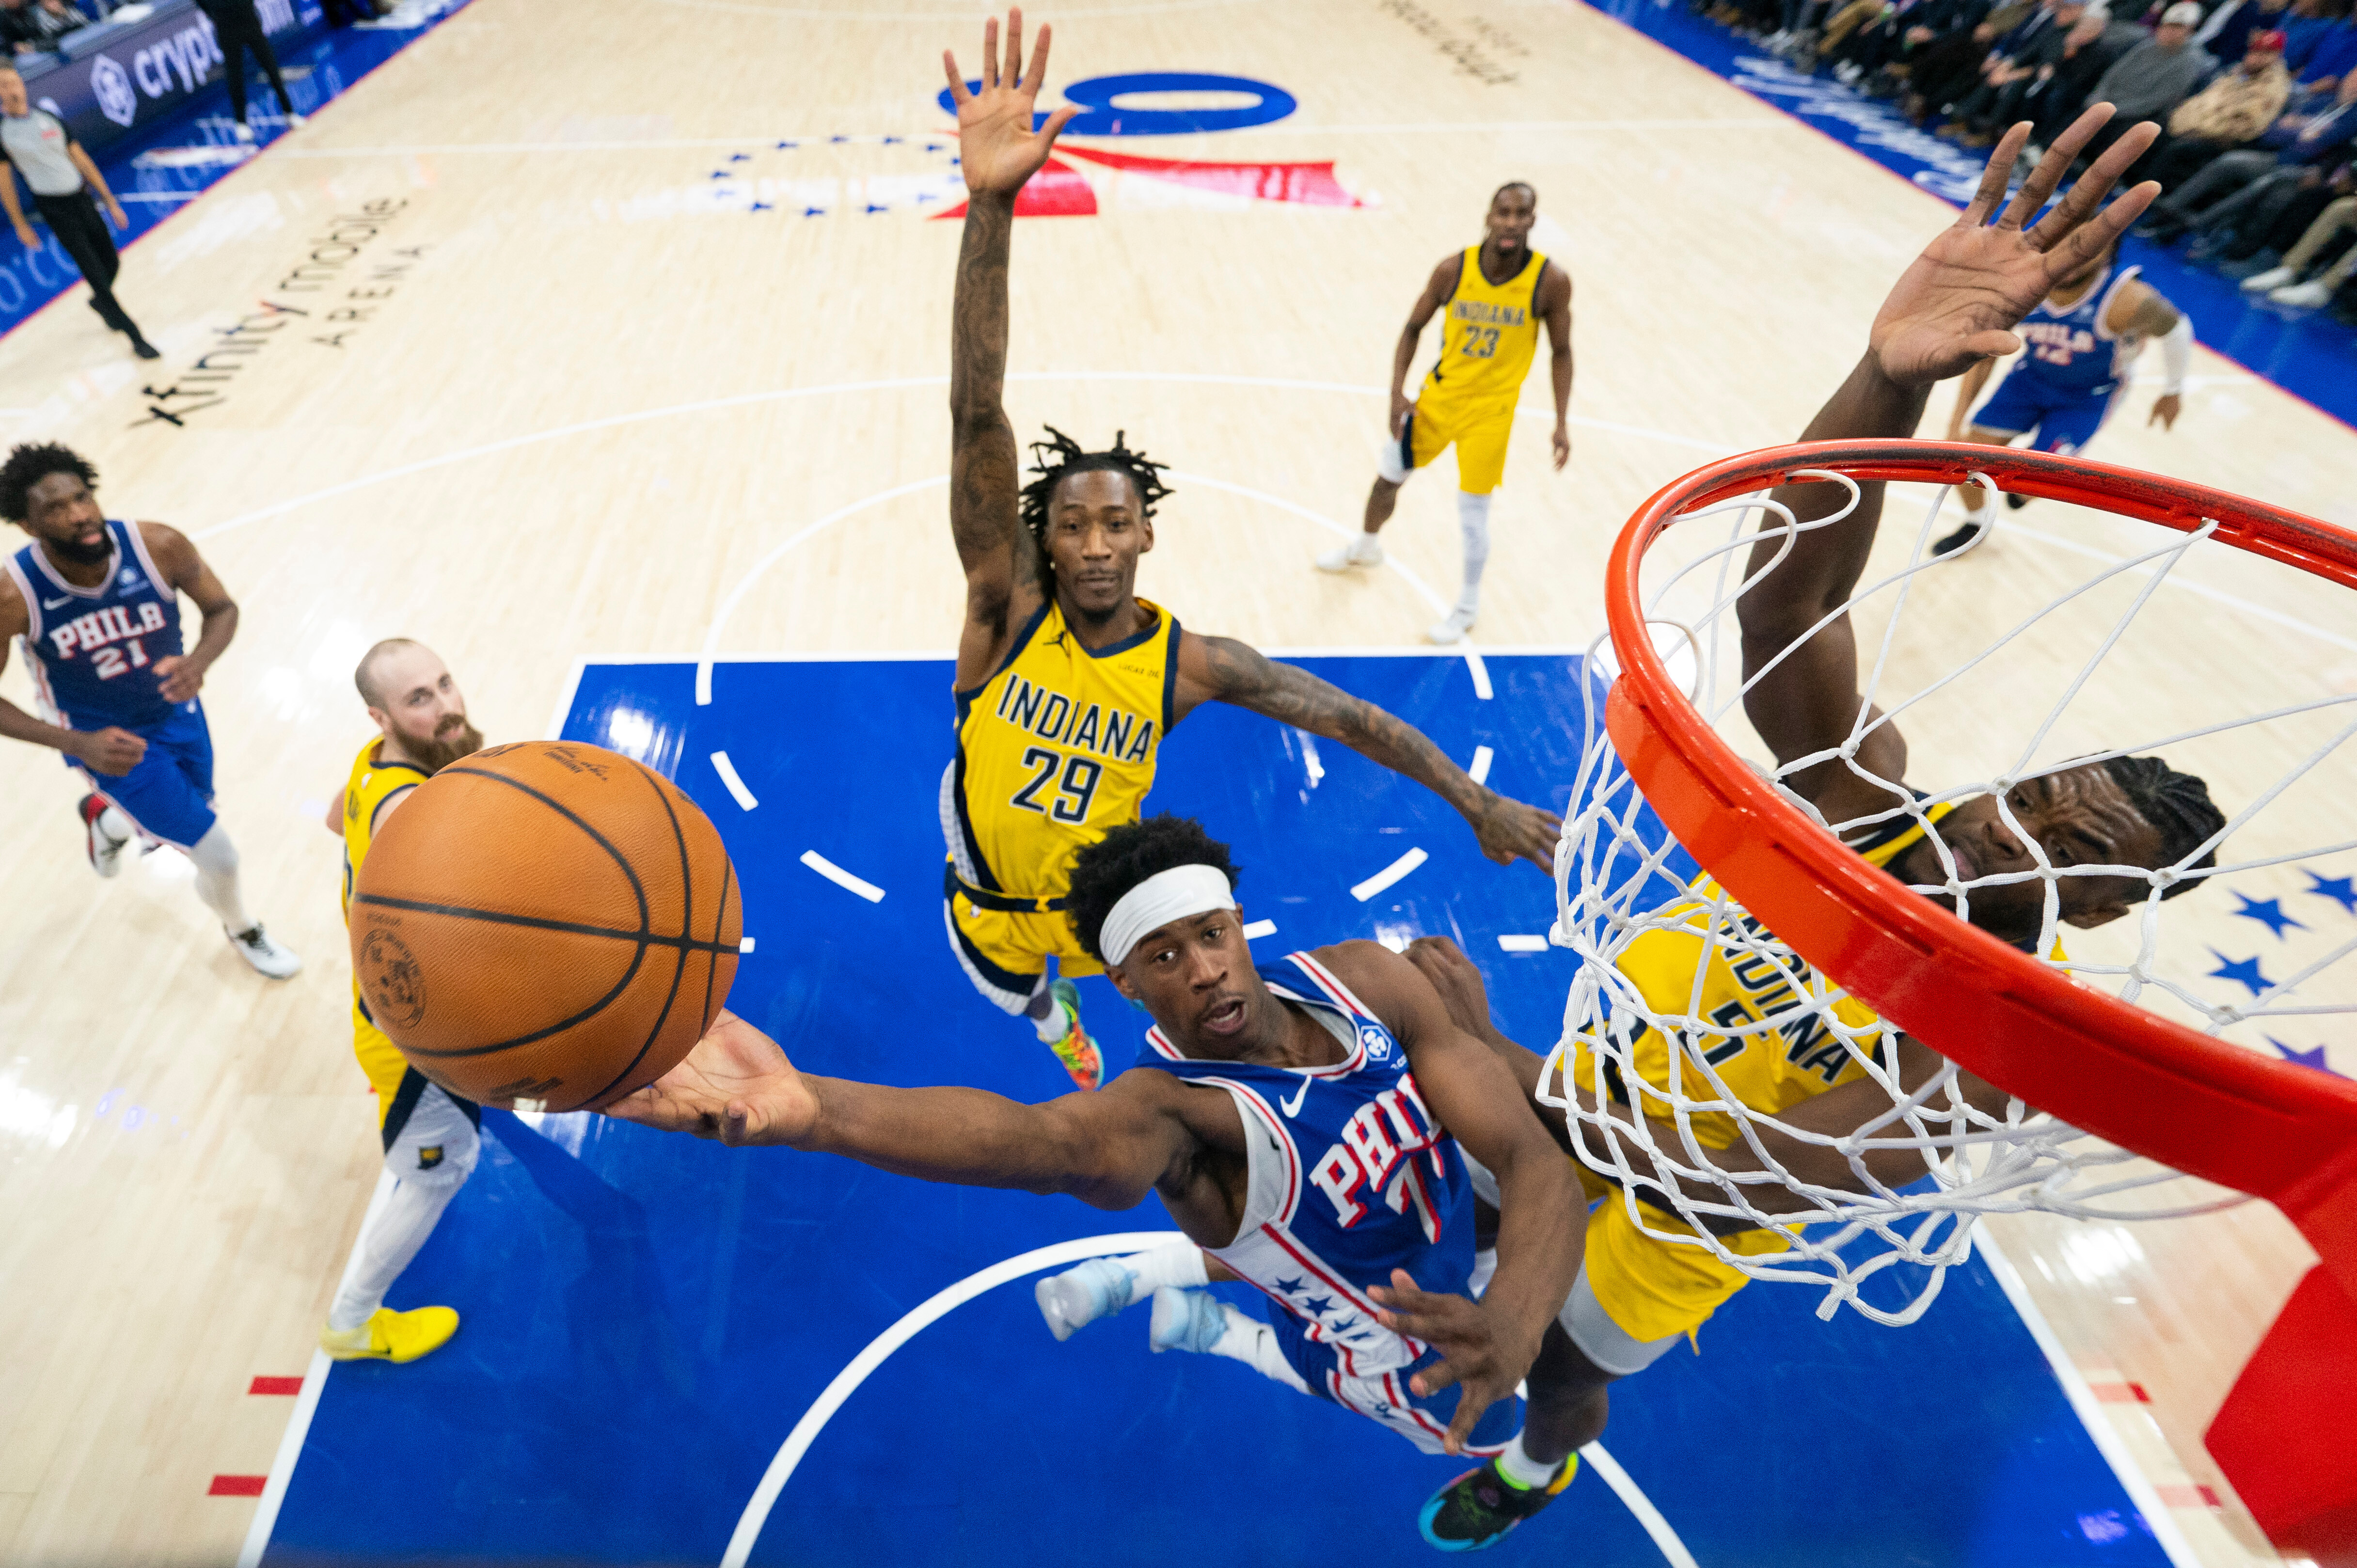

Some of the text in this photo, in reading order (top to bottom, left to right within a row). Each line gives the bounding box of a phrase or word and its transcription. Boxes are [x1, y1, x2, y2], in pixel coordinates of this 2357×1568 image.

[134, 9, 225, 98] crypt
[125, 198, 409, 428] xfinity mobile
[1460, 325, 1501, 359] 23
[49, 602, 166, 660] PHILA
[91, 638, 149, 680] 21
[996, 672, 1155, 764] INDIANA
[1009, 746, 1104, 826] 29
[1676, 998, 1769, 1068] 5
[1710, 912, 1860, 1086] NDIANA
[1309, 1072, 1446, 1229] PHIL
